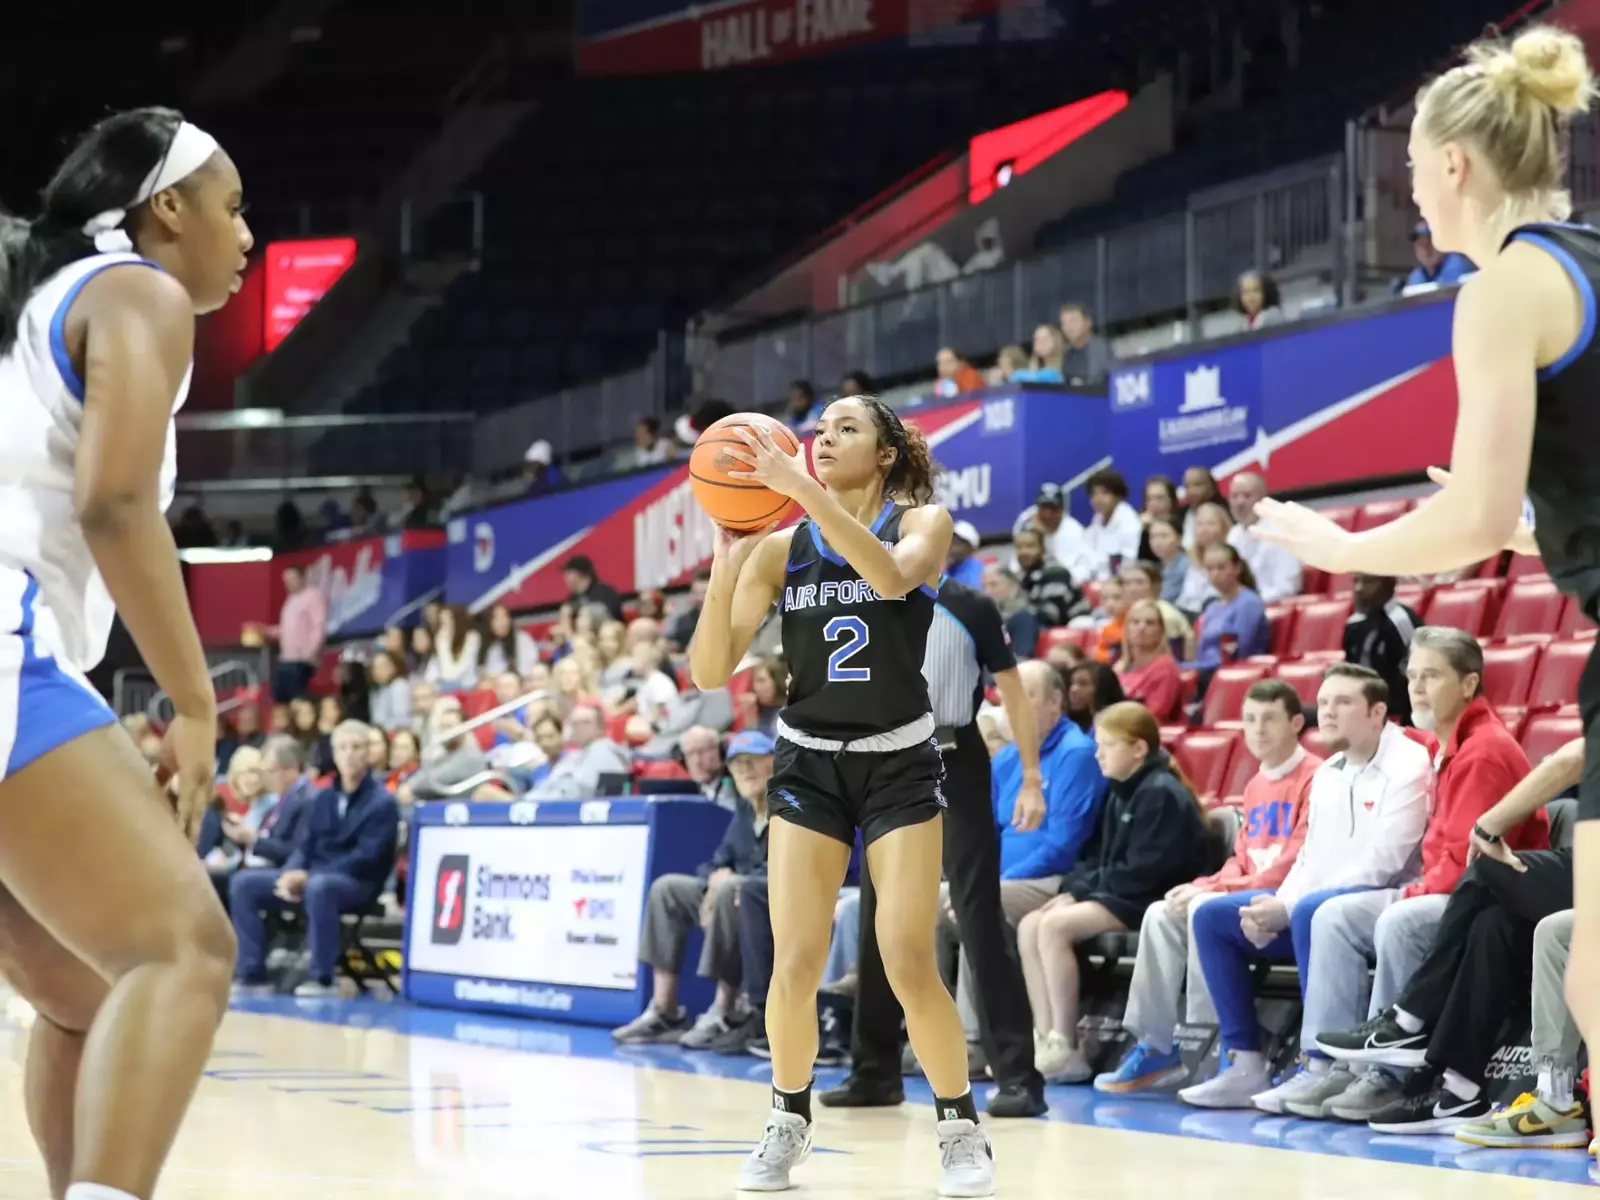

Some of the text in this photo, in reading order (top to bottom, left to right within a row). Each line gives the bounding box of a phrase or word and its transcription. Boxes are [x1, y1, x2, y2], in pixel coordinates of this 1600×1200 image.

[702, 8, 771, 70] HALL
[797, 0, 875, 46] FAME
[1115, 371, 1149, 405] 104
[932, 463, 991, 511] SMU
[785, 579, 906, 612] AIR FOR
[823, 615, 870, 682] 2
[475, 864, 550, 901] Simmons
[1491, 1045, 1533, 1063] AUTO
